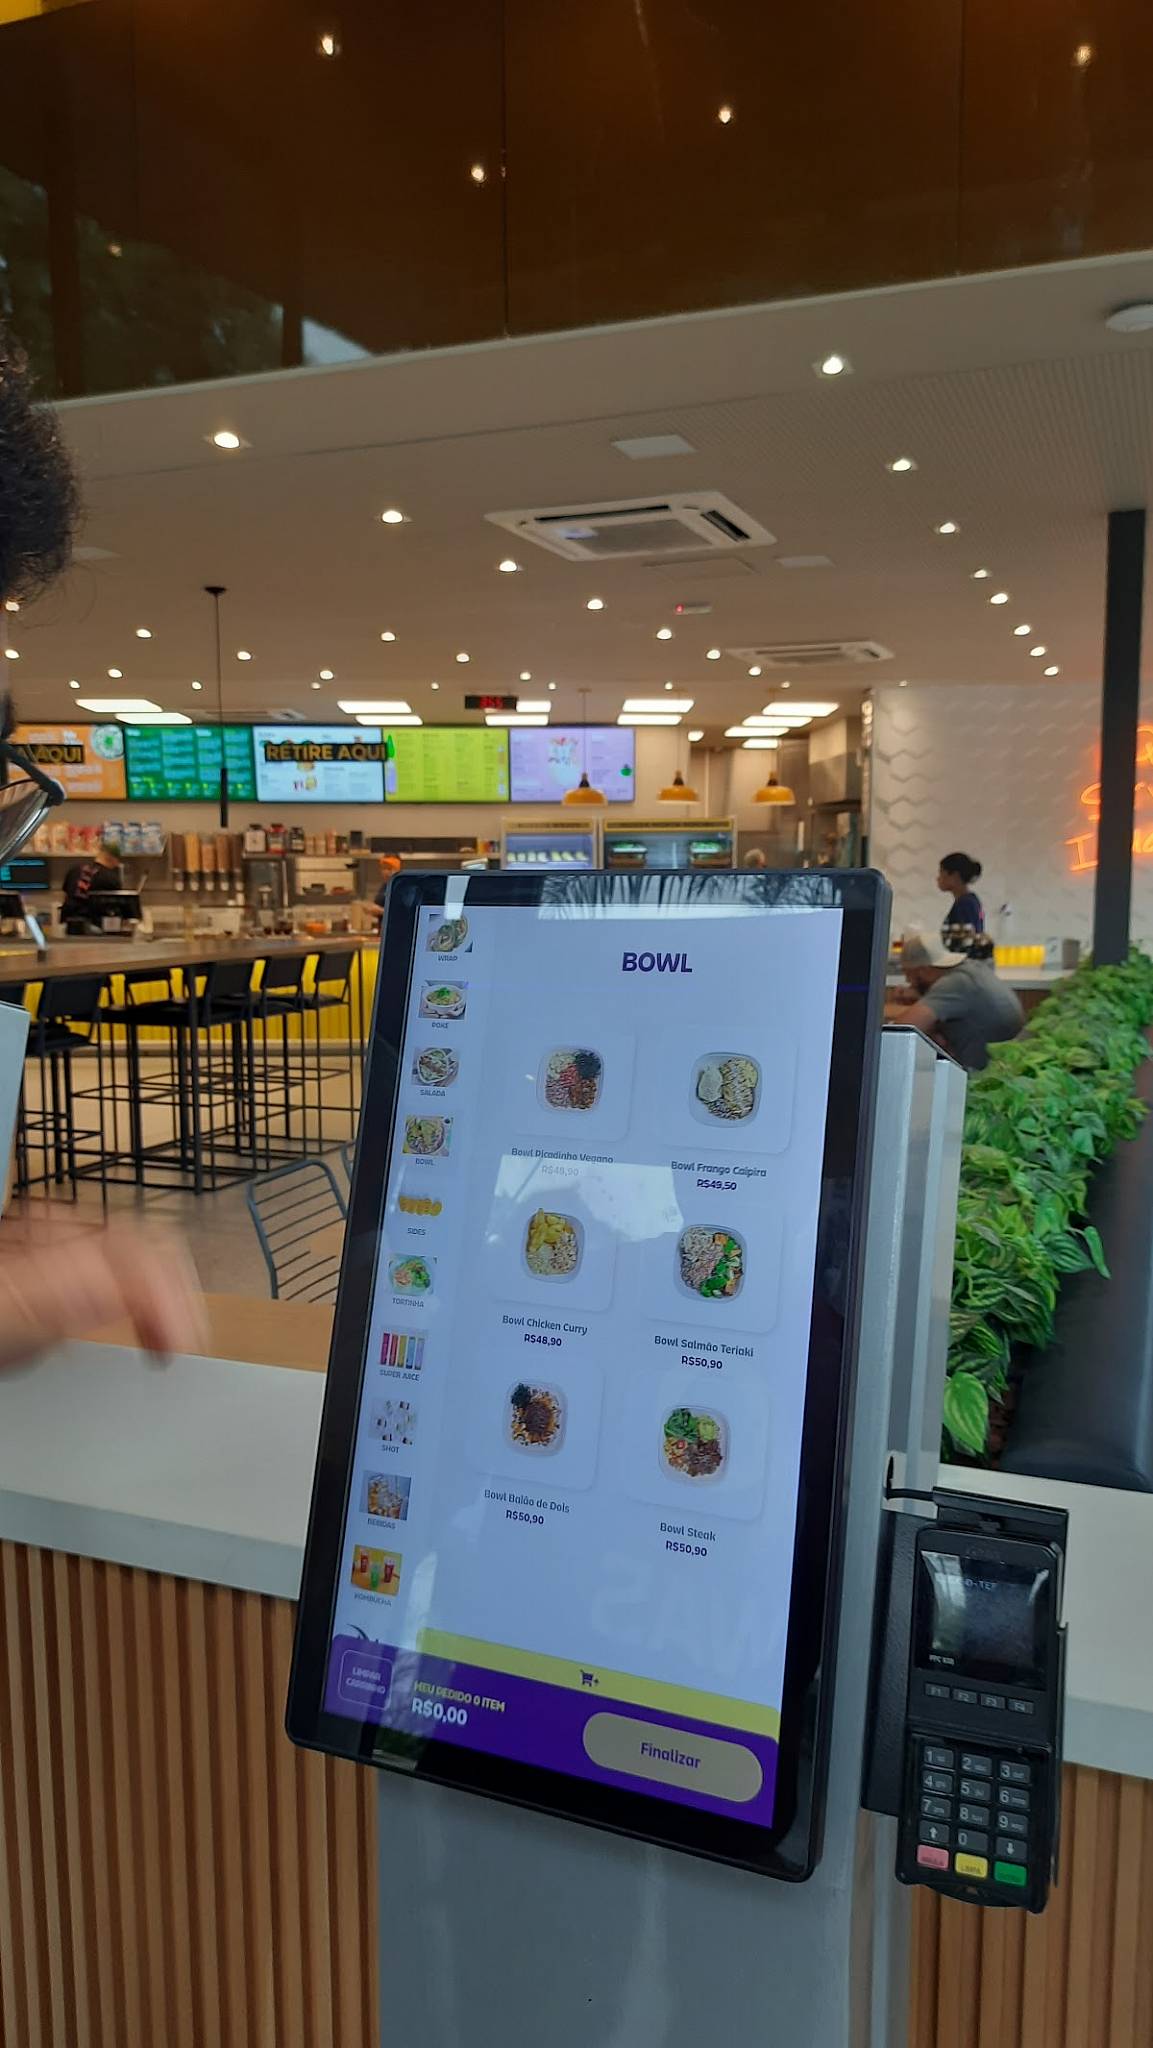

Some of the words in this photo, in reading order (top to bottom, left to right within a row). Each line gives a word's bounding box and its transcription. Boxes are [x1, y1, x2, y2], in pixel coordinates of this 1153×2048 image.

[37, 745, 82, 764] AQUI
[266, 745, 334, 760] RETIRE
[338, 745, 385, 761] AQUI
[622, 952, 693, 973] BOWL
[420, 1089, 446, 1097] SALADA
[511, 1147, 534, 1158] Bowl
[535, 1149, 578, 1161] Picadinho
[580, 1153, 614, 1165] Vegano
[671, 1160, 695, 1172] Bowl
[697, 1163, 731, 1176] Frango
[732, 1166, 767, 1178] Caipira
[407, 1227, 426, 1236] SIDES
[502, 1315, 525, 1326] Bowl
[526, 1318, 561, 1331] Chicken
[563, 1323, 588, 1336] Curry
[524, 1333, 562, 1347] R$48,90
[654, 1335, 679, 1347] Bowl
[680, 1338, 719, 1352] Salmão
[720, 1344, 754, 1357] Teriaki
[681, 1355, 723, 1370] R$50,90
[381, 1444, 400, 1454] SHOT
[484, 1489, 507, 1501] Bowl
[536, 1499, 548, 1509] de
[549, 1501, 570, 1513] Dois
[505, 1509, 545, 1525] R$50,90
[660, 1522, 685, 1536] Bowl
[687, 1527, 716, 1541] Steak
[665, 1540, 708, 1557] R$50,90
[414, 1681, 433, 1694] MEU
[435, 1686, 472, 1703] PEDIDO
[481, 1697, 506, 1712] ITEM
[411, 1697, 468, 1725] R$0,00
[641, 1742, 701, 1768] Finalizar
[926, 1751, 933, 1762] 1
[962, 1757, 972, 1770] 2
[1000, 1765, 1010, 1778] 3
[924, 1775, 933, 1787] 4
[960, 1782, 970, 1795] 5
[1000, 1790, 1009, 1803] 6
[923, 1798, 932, 1812] 7
[960, 1807, 968, 1820] 8
[999, 1815, 1008, 1828] 9
[958, 1832, 967, 1845] 0
